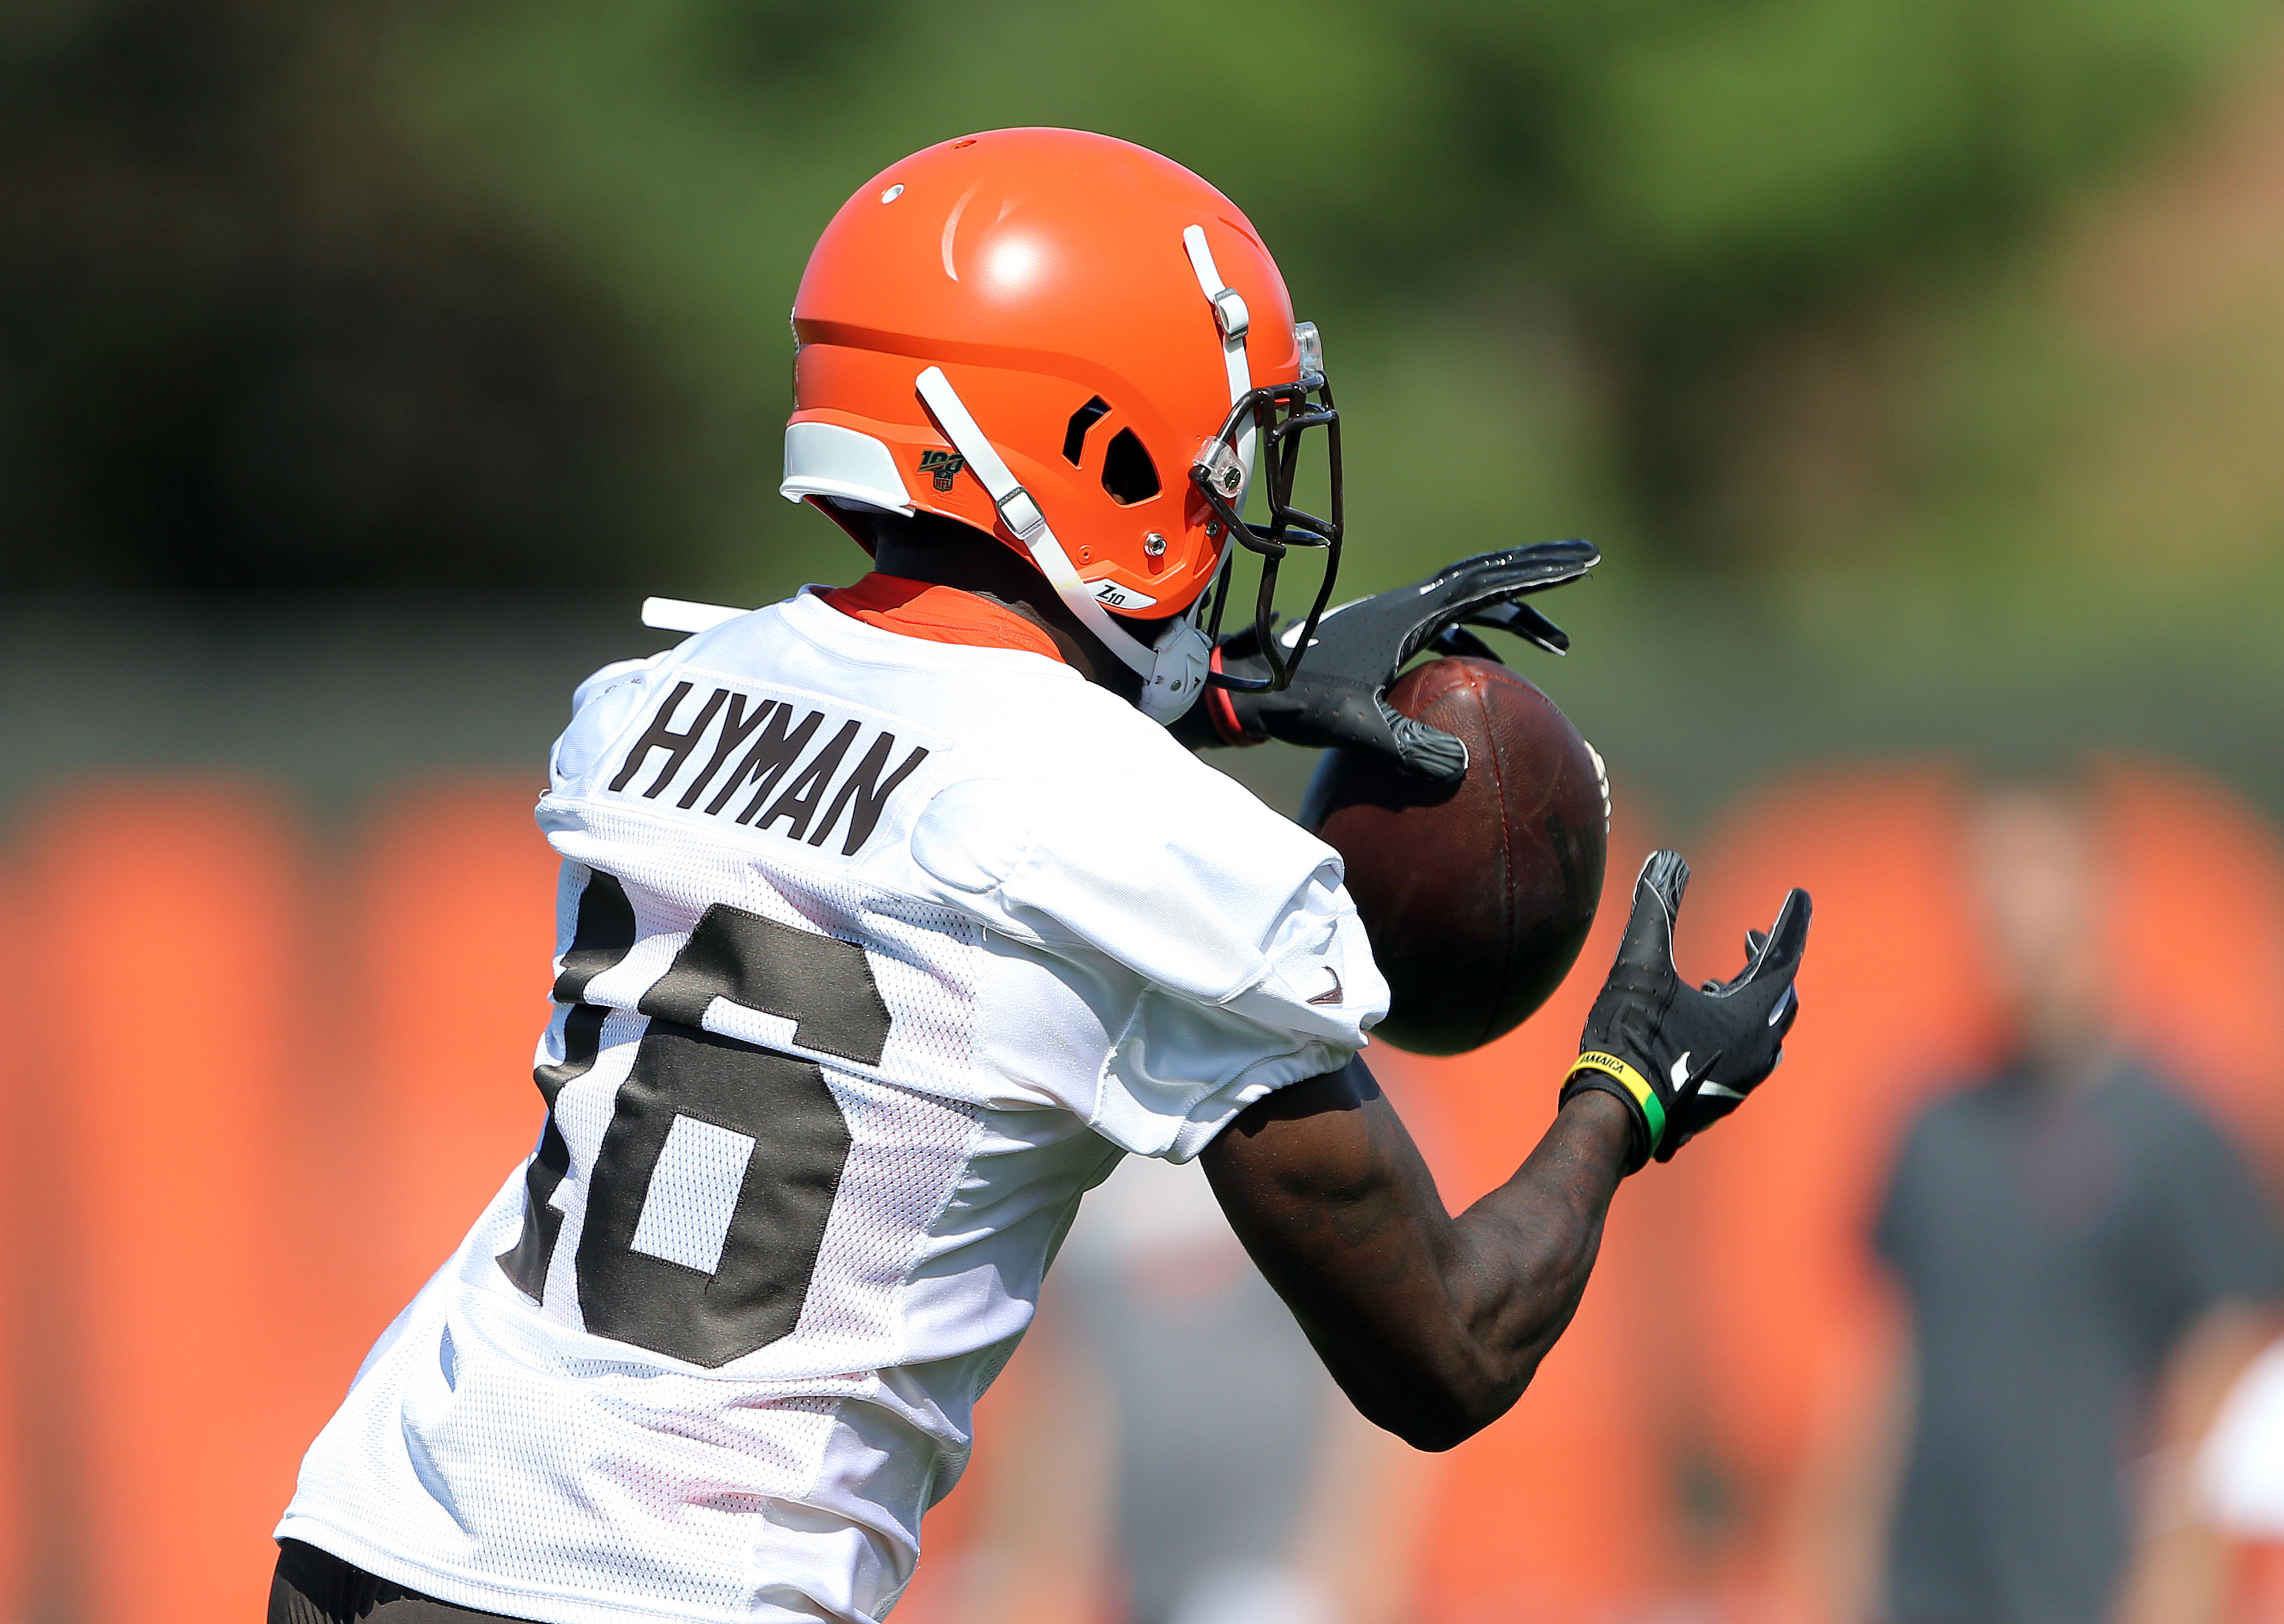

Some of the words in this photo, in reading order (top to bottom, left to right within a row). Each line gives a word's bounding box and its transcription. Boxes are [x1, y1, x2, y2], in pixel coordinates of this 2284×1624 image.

[921, 450, 965, 475] 100
[608, 681, 929, 856] HYMAN
[1579, 1053, 1625, 1074] JAMAICA
[495, 864, 892, 1369] 16
